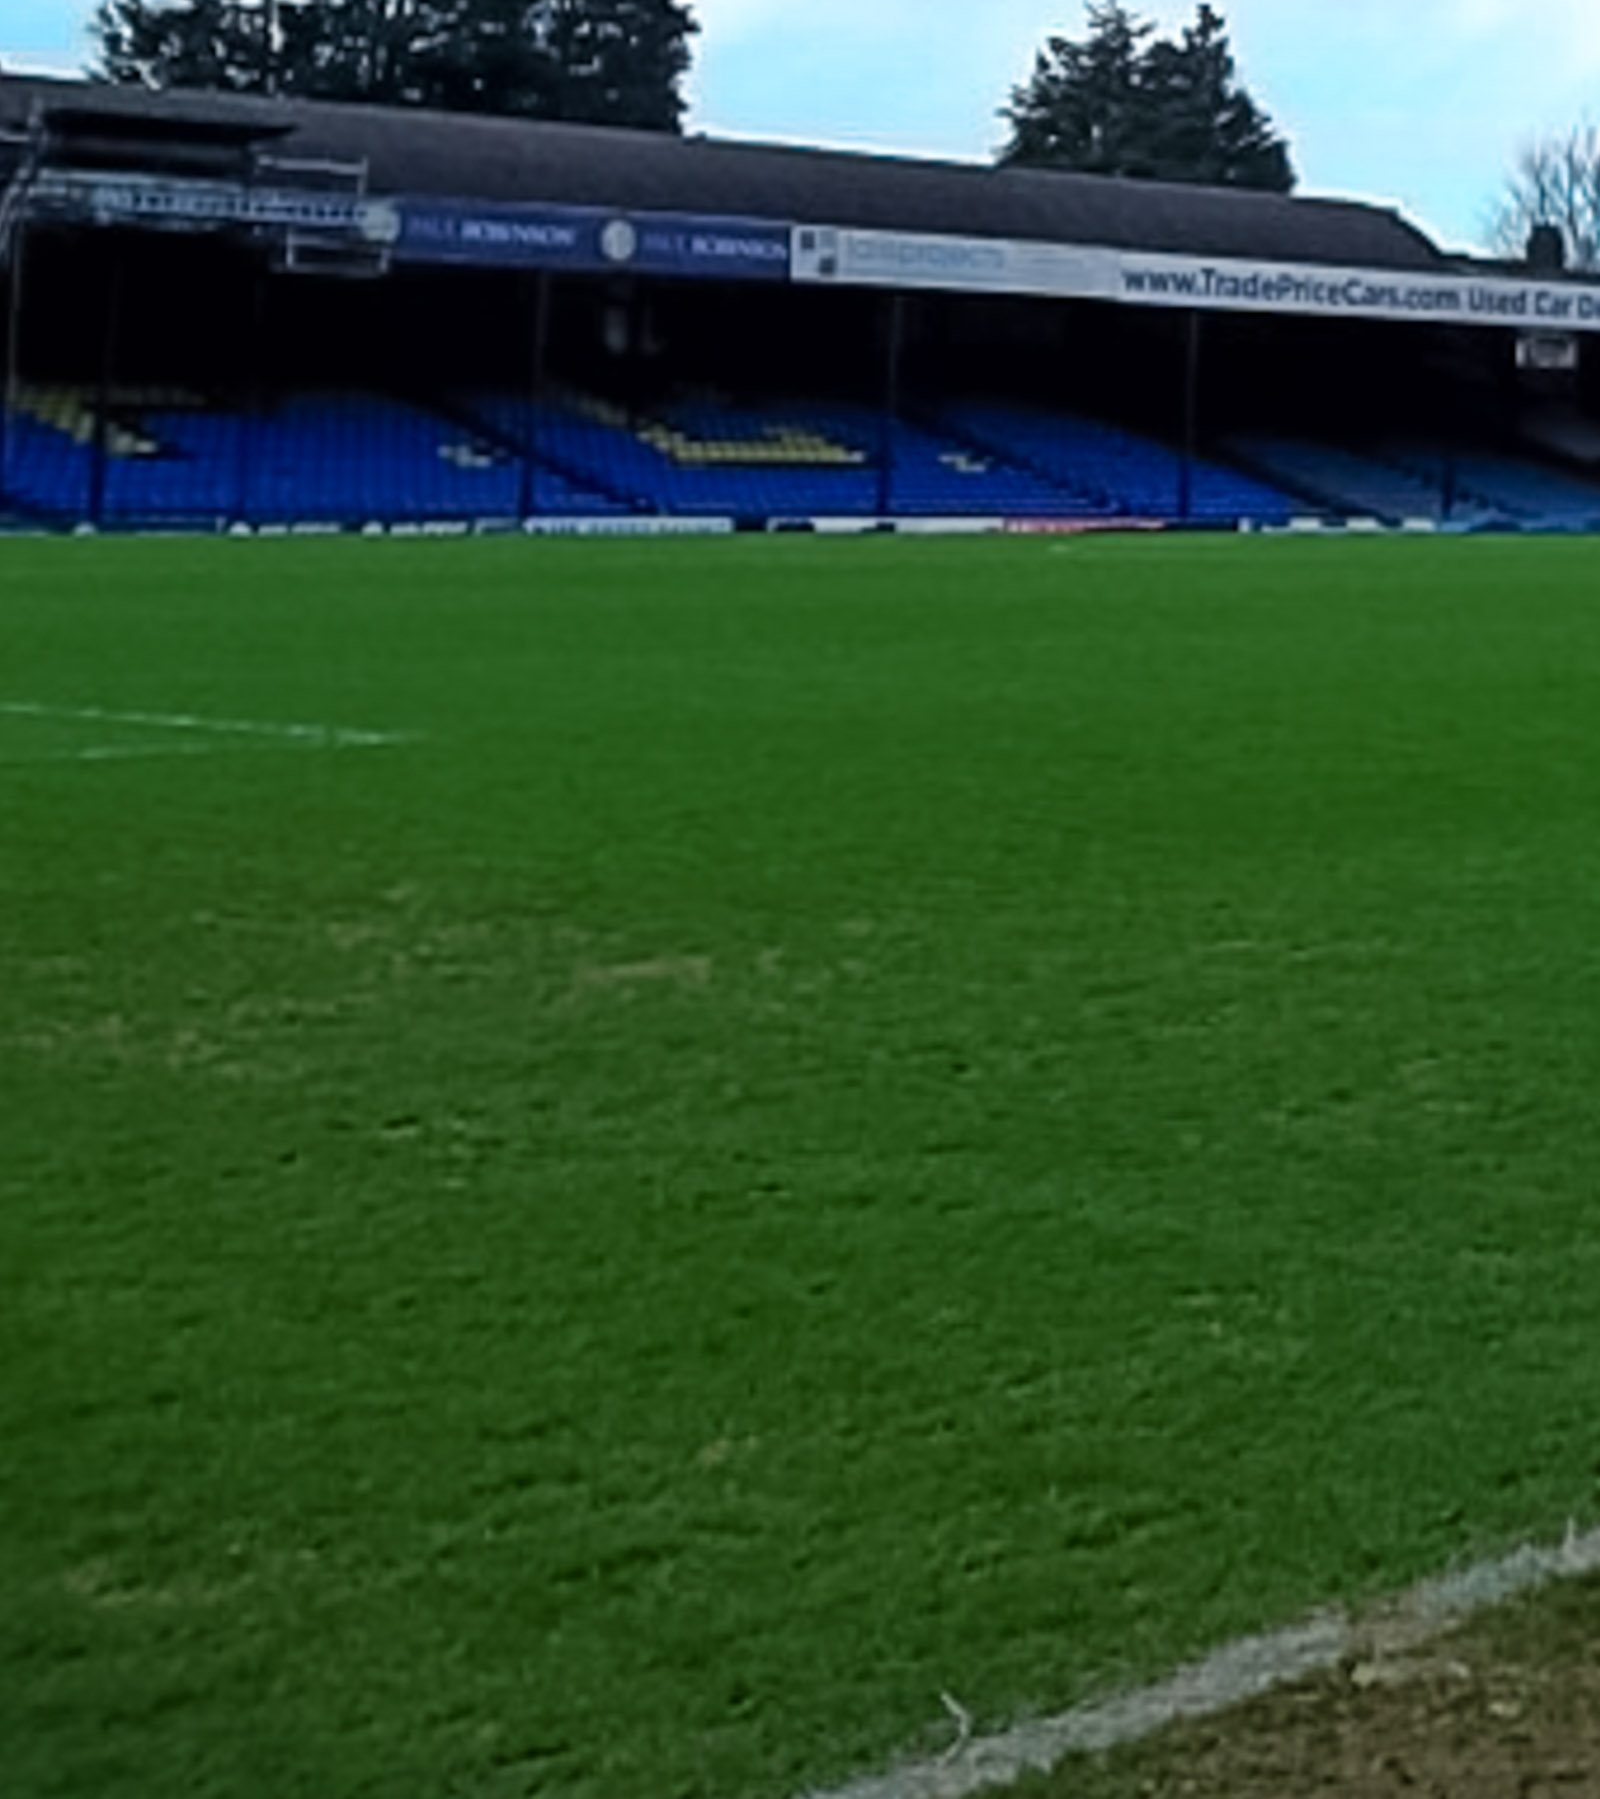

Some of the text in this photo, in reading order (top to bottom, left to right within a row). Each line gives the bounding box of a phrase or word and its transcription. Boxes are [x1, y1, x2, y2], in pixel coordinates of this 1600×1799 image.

[1122, 267, 1461, 311] www.TradePriceCars.com
[1468, 287, 1526, 316] Used
[1534, 290, 1573, 317] Car
